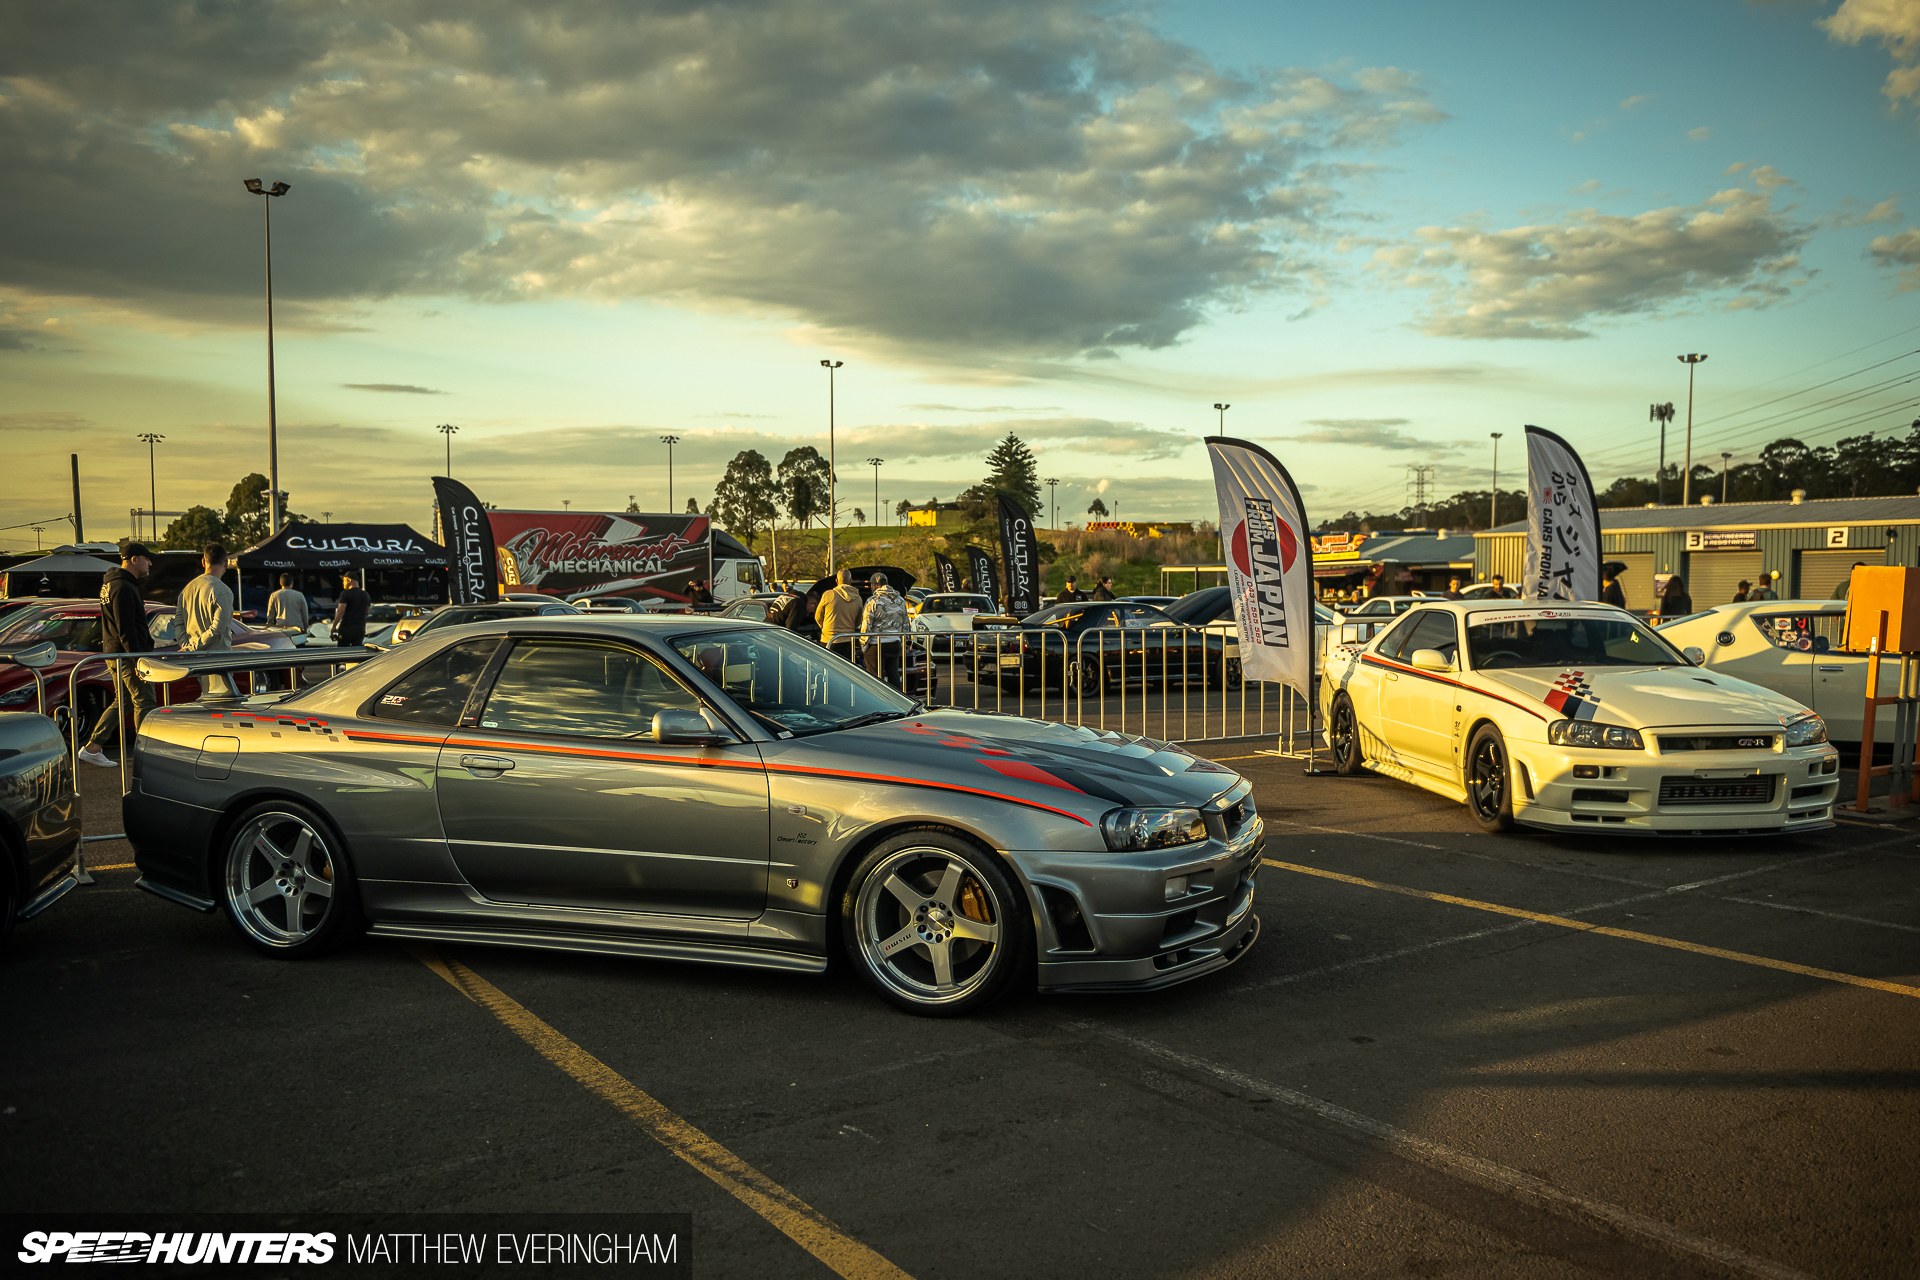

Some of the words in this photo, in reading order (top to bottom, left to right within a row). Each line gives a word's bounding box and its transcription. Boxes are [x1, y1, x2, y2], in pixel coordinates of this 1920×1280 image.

[1246, 500, 1264, 543] FROM
[1260, 501, 1276, 540] CARS
[1542, 508, 1552, 542] CARS
[1831, 531, 1844, 544] 2
[286, 536, 424, 551] CULTURA
[463, 506, 486, 604] CULTURA
[514, 528, 689, 577] Motorsports
[1014, 518, 1030, 597] CULTURA
[1690, 534, 1701, 547] 3
[550, 560, 667, 573] MECHANICAL
[1539, 545, 1552, 581] FROM
[1246, 581, 1256, 604] 0431
[1251, 606, 1259, 624] 555
[1252, 544, 1288, 646] JAPAN
